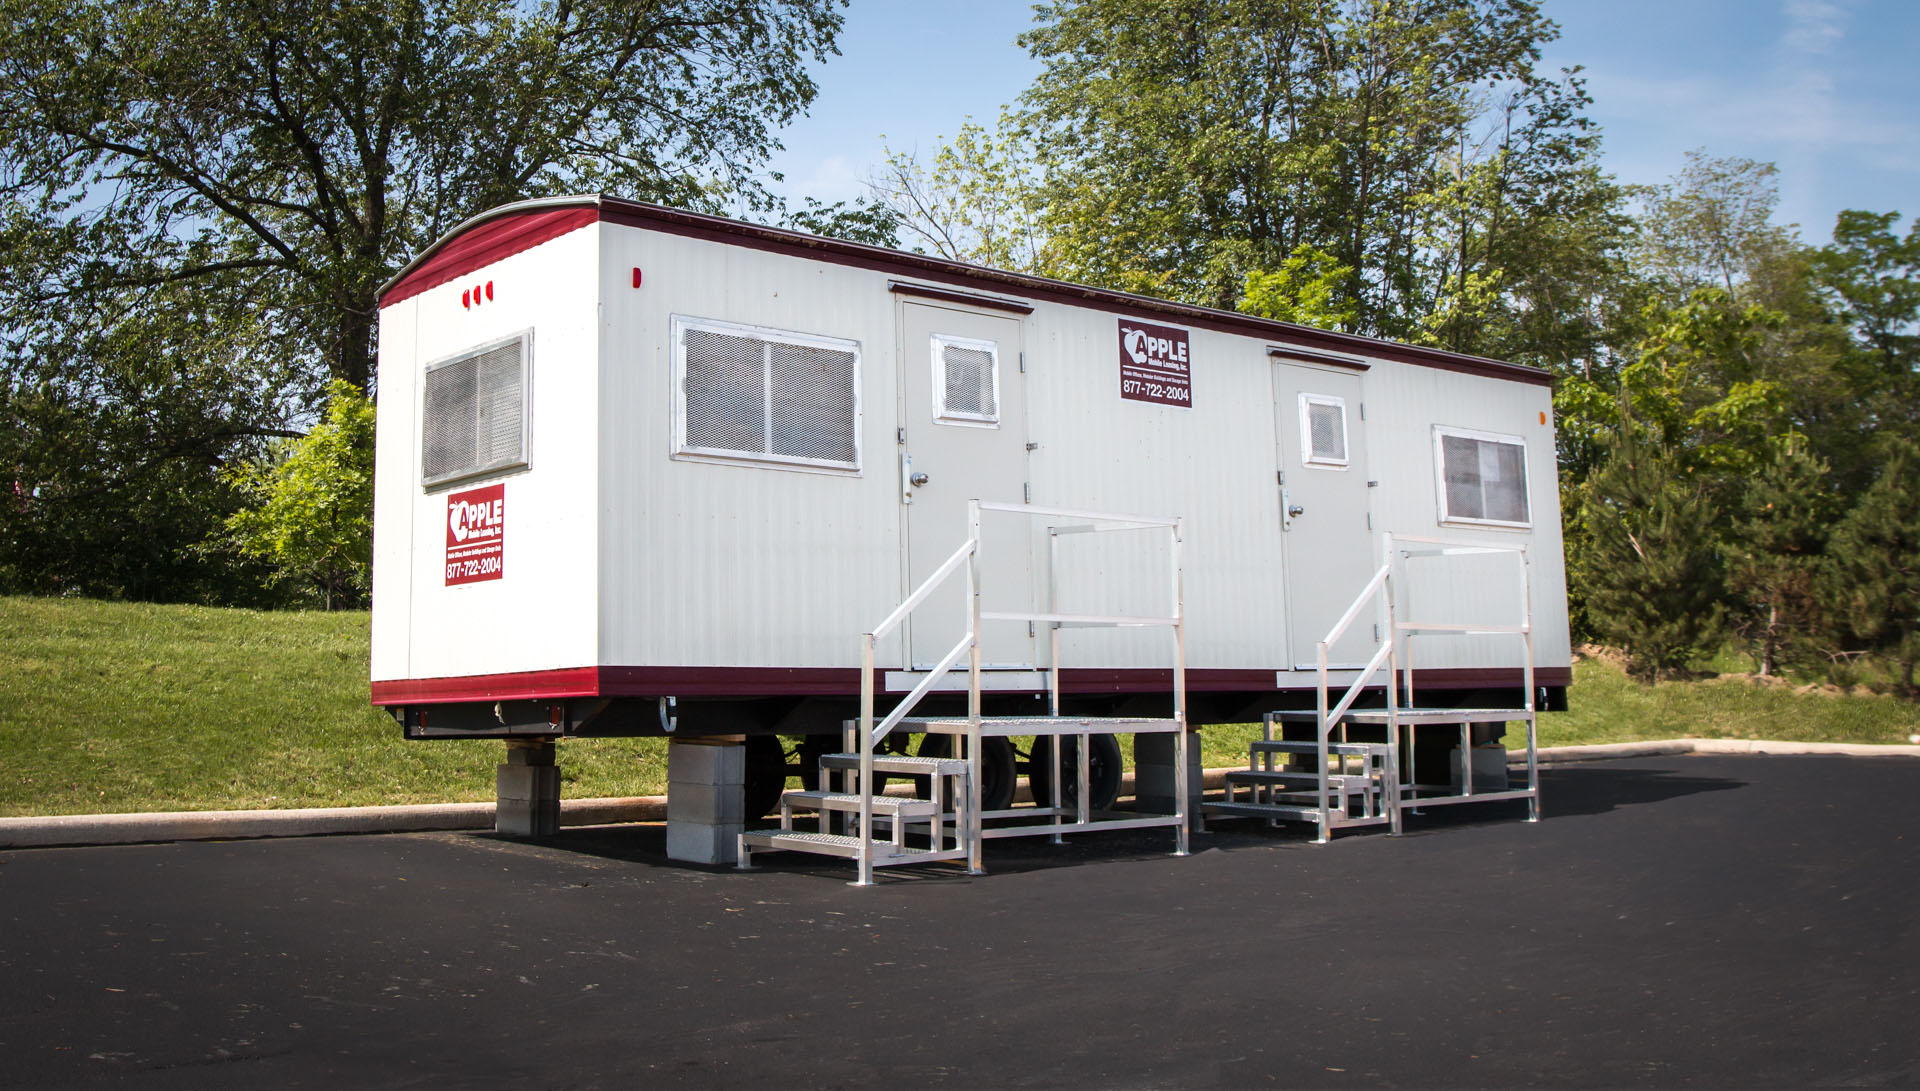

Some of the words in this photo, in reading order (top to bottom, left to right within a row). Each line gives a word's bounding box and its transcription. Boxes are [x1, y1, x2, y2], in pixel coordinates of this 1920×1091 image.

[1135, 335, 1187, 362] APPLE
[1123, 379, 1189, 401] 877-722-2004
[459, 499, 502, 530] APPLE
[447, 556, 501, 579] 877-722-2004
